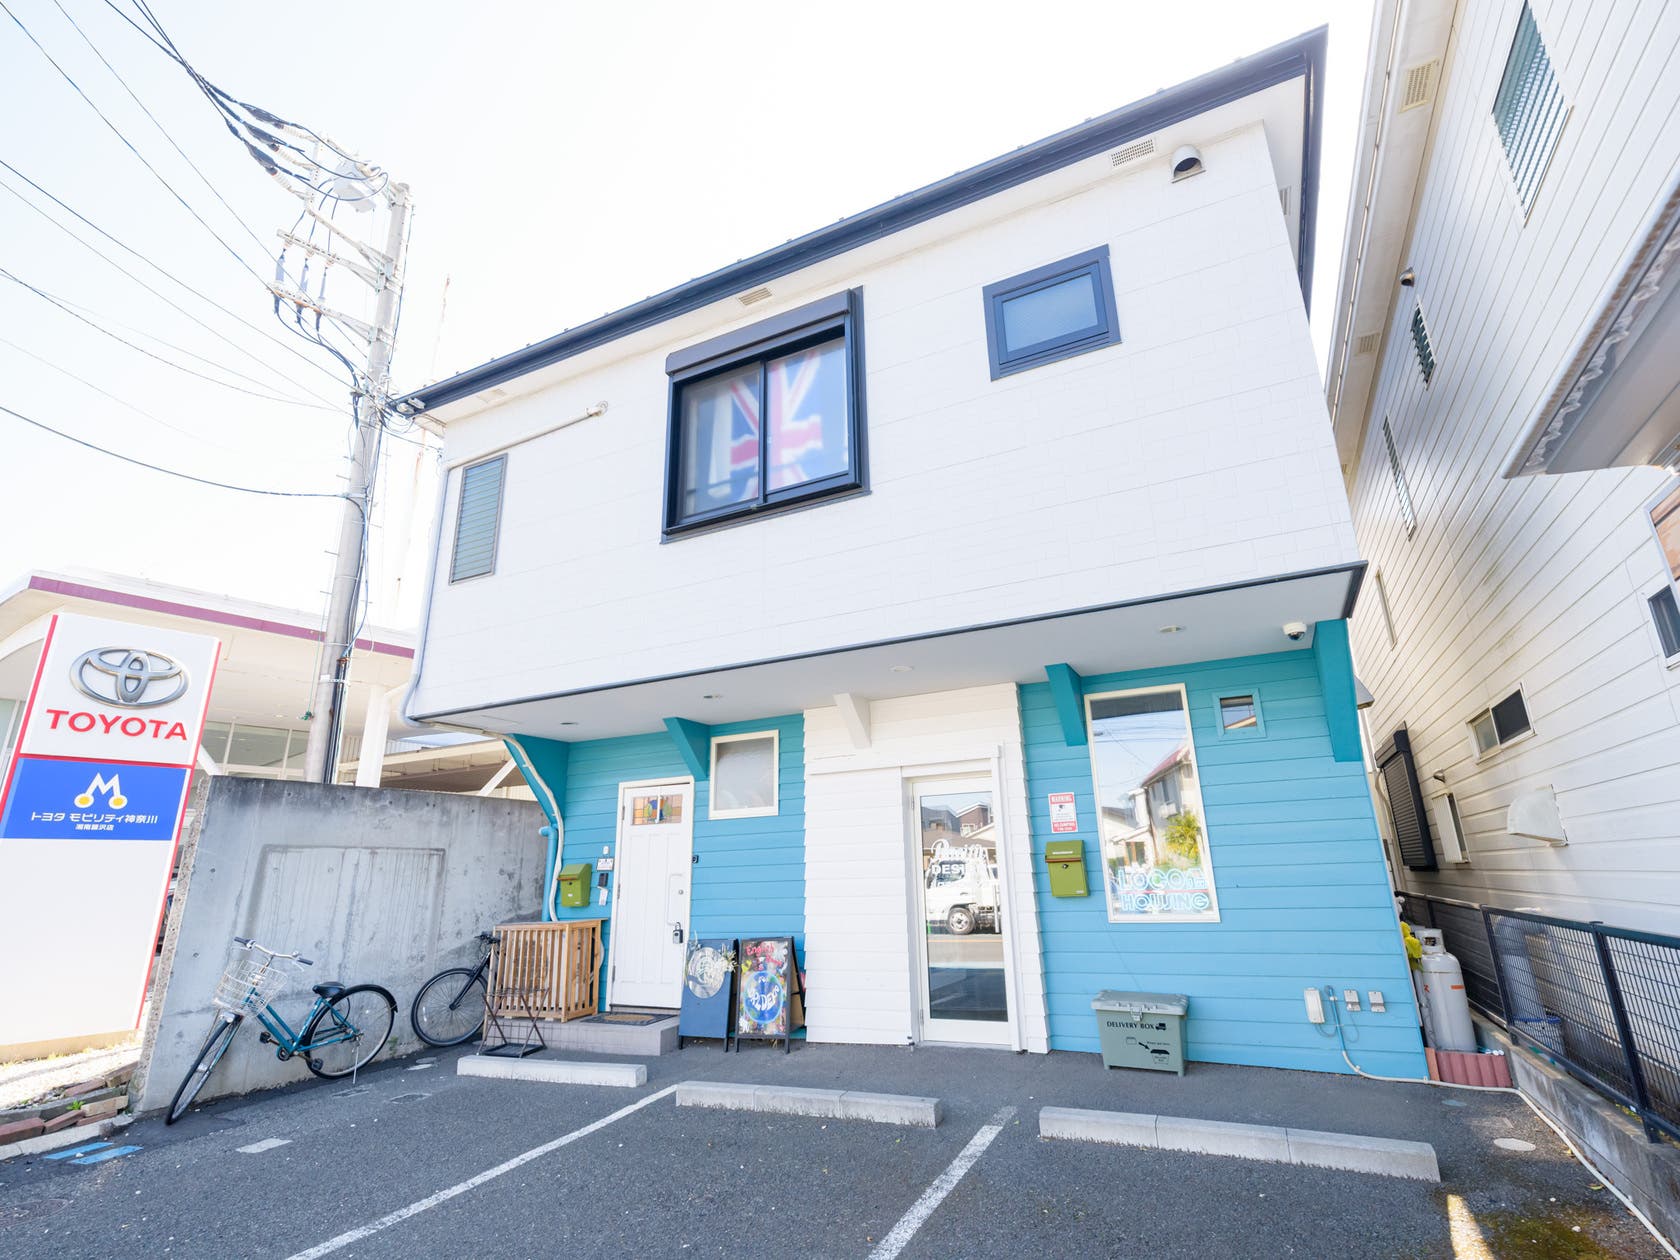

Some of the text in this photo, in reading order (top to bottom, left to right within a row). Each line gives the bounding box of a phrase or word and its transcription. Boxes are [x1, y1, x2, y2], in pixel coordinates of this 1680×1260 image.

[46, 709, 187, 741] TOYOTA
[31, 811, 66, 822] トヨタ
[1118, 868, 1185, 890] LOCO
[1121, 892, 1210, 911] HOUSING
[1106, 1021, 1137, 1029] DELIVERY
